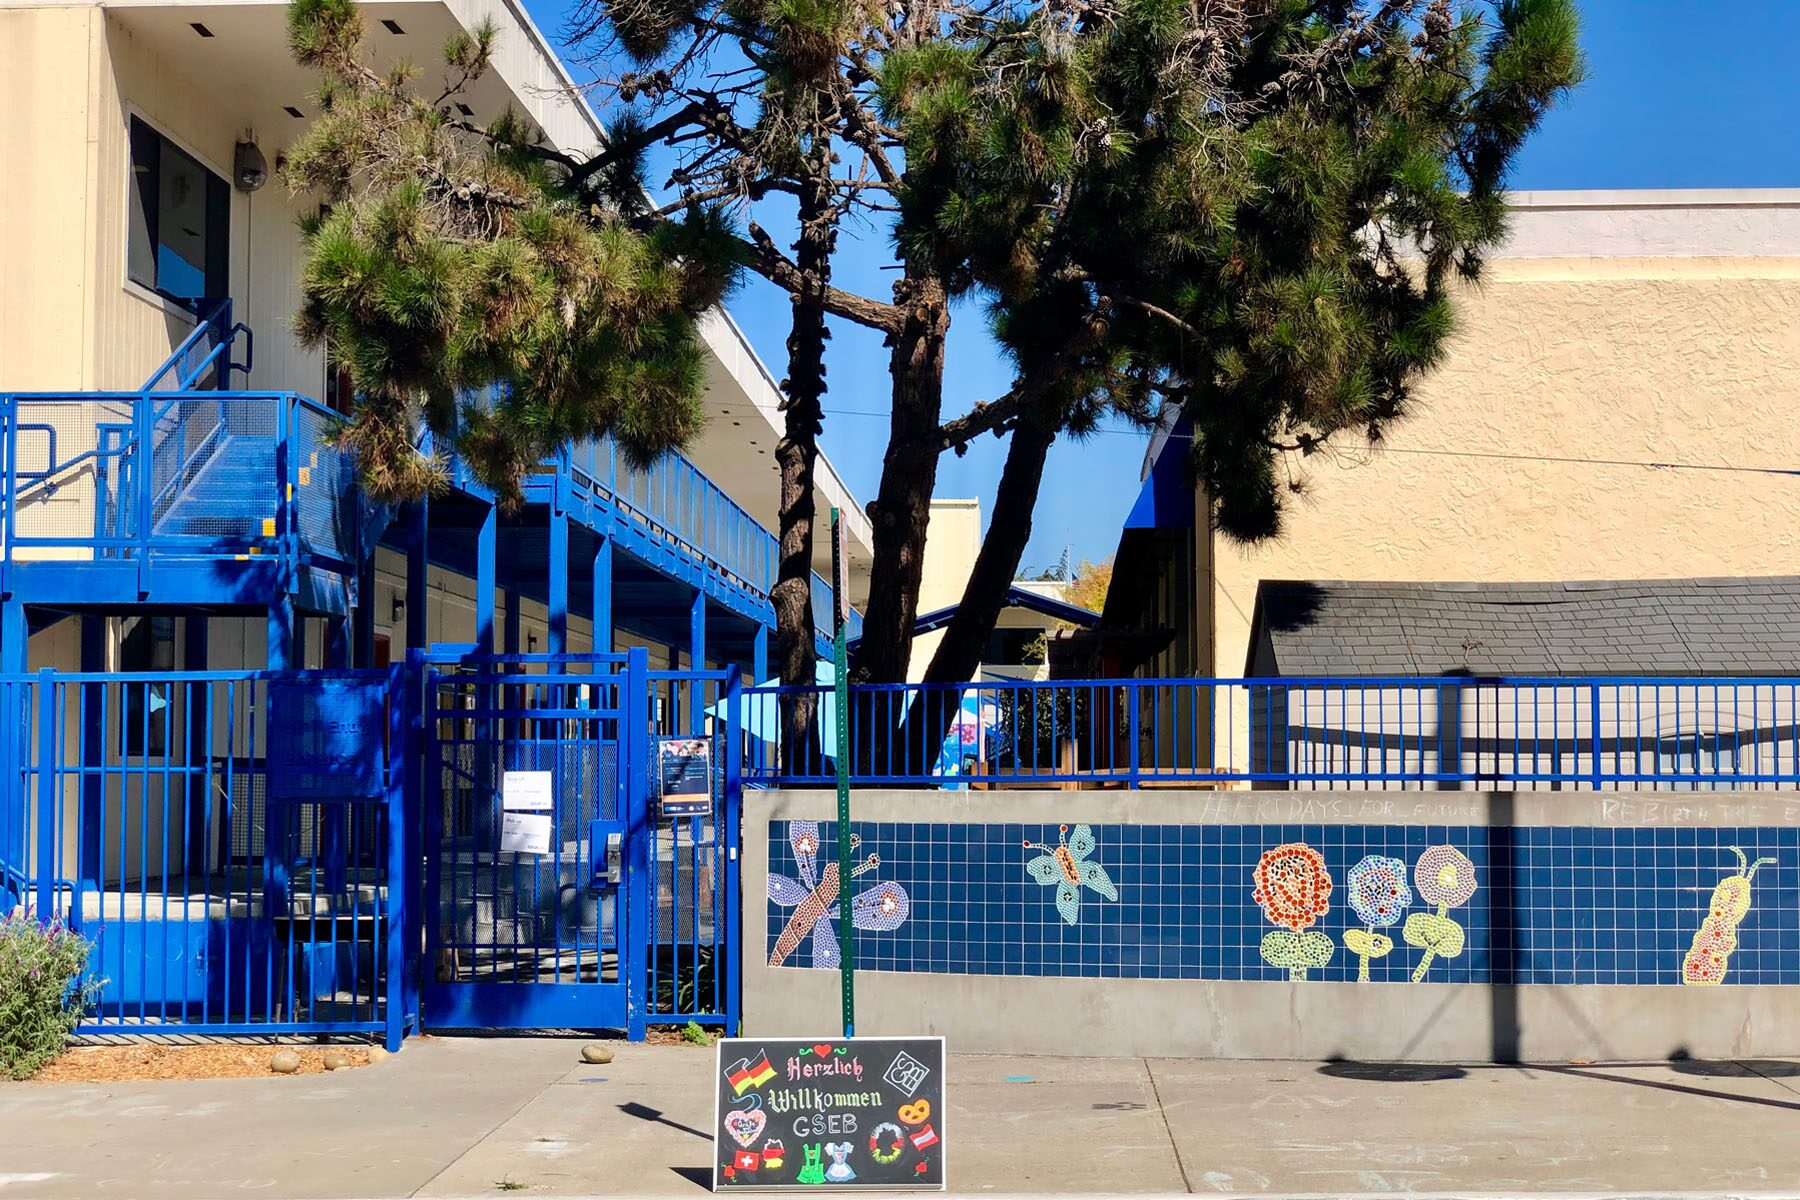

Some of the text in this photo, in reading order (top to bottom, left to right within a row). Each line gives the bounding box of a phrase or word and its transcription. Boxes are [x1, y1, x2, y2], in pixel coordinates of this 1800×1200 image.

[787, 1056, 863, 1082] Herzlich
[768, 1088, 882, 1112] Willkommen
[793, 1113, 858, 1137] GSEB
